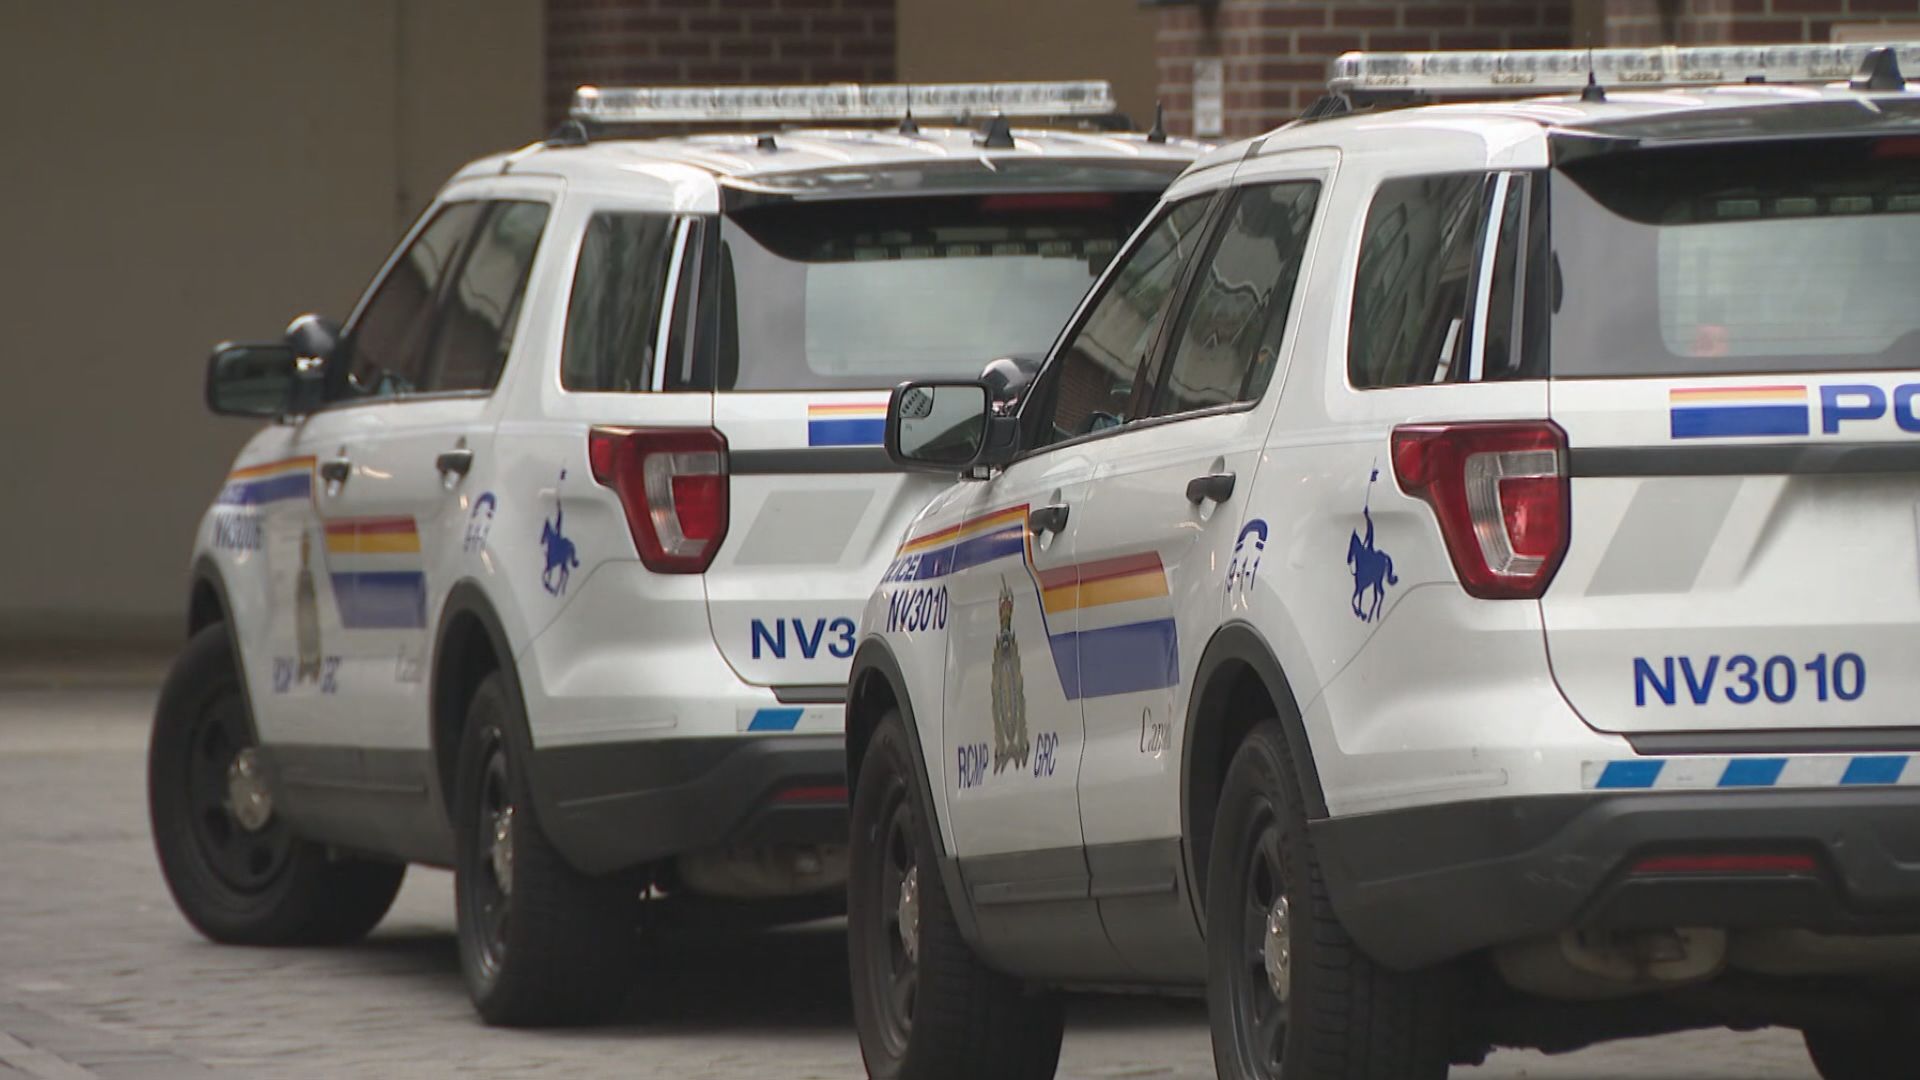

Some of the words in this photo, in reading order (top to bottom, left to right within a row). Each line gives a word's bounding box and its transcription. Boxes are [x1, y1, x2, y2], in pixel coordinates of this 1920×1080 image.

[886, 584, 948, 633] NV3010
[1633, 652, 1867, 707] NV3010
[958, 741, 989, 789] RCMP
[1034, 731, 1059, 777] GRC
